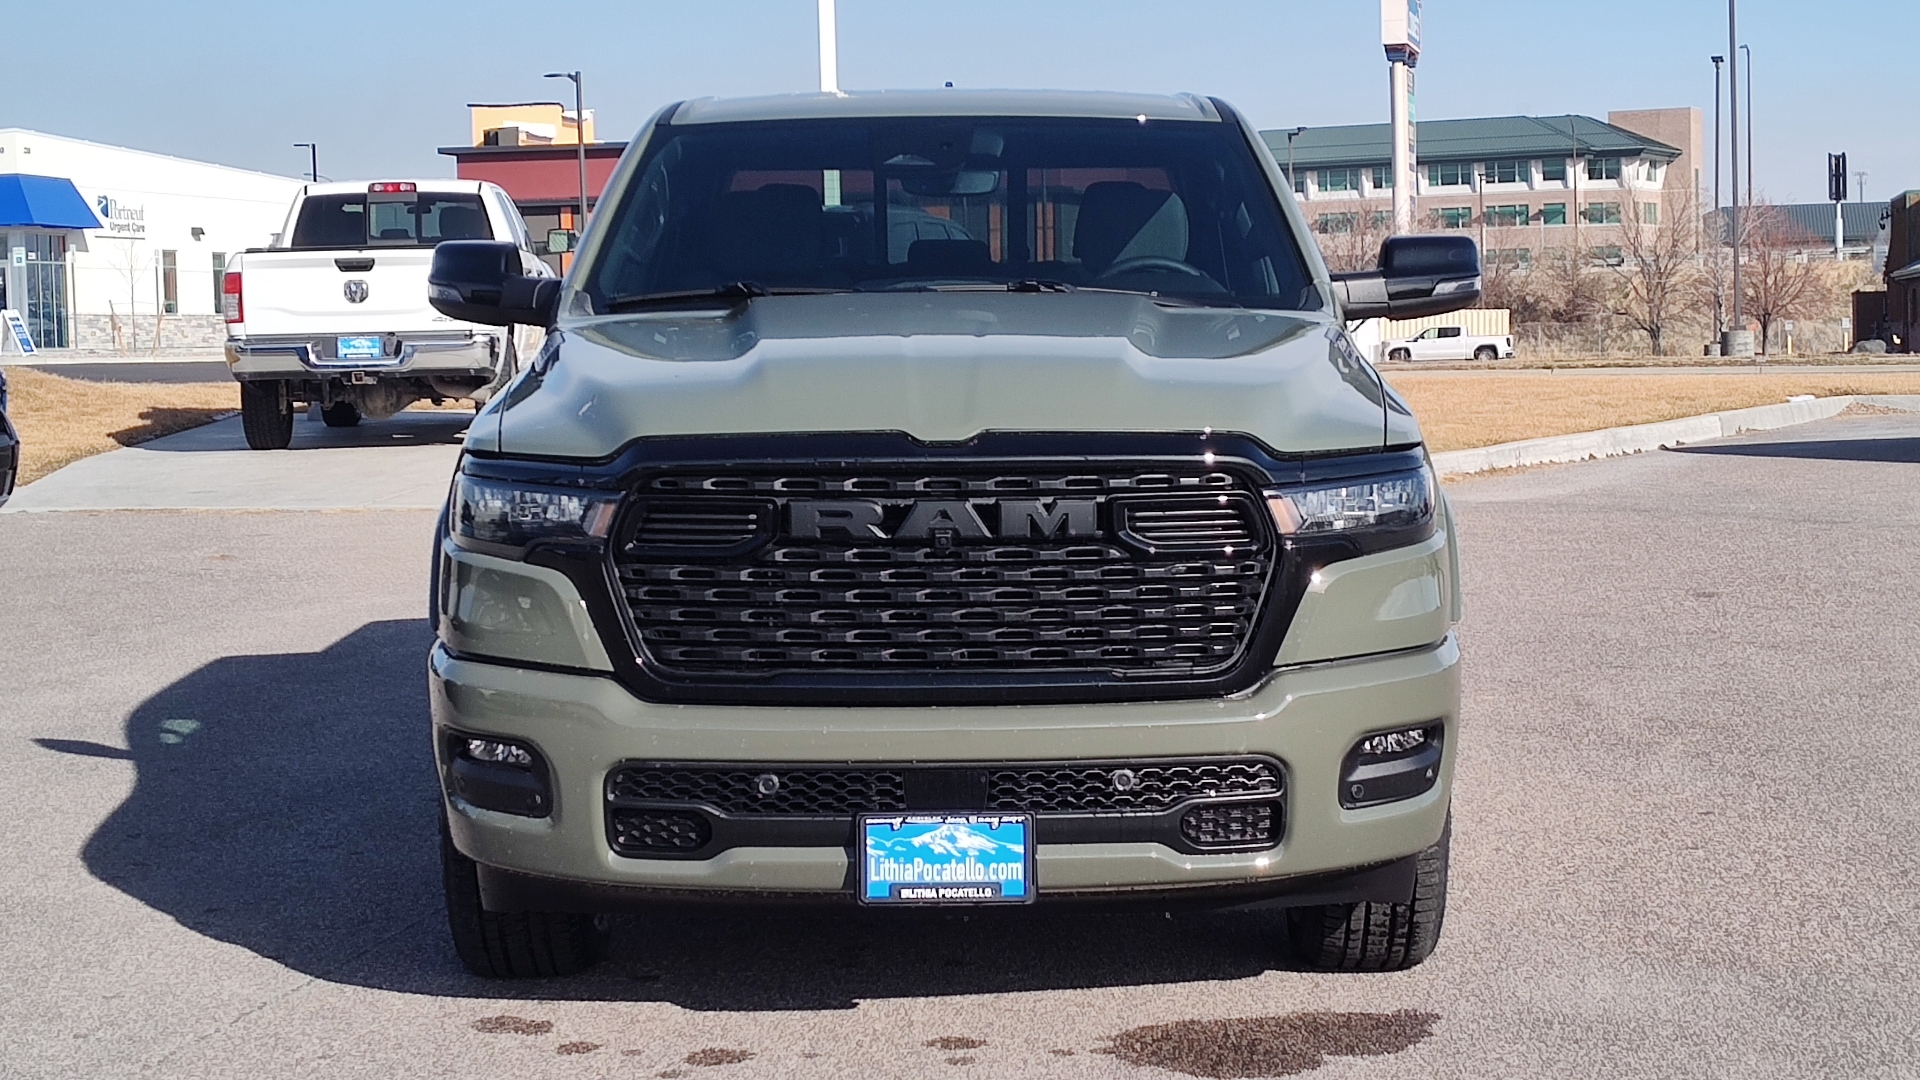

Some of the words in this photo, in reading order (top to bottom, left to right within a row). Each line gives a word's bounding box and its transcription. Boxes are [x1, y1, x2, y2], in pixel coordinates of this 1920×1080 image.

[109, 221, 131, 233] Urgent
[788, 500, 1097, 538] RAM
[870, 857, 1022, 881] LithiaPocatello.com
[909, 888, 938, 899] LITHIA
[938, 887, 993, 898] POCATELLO
